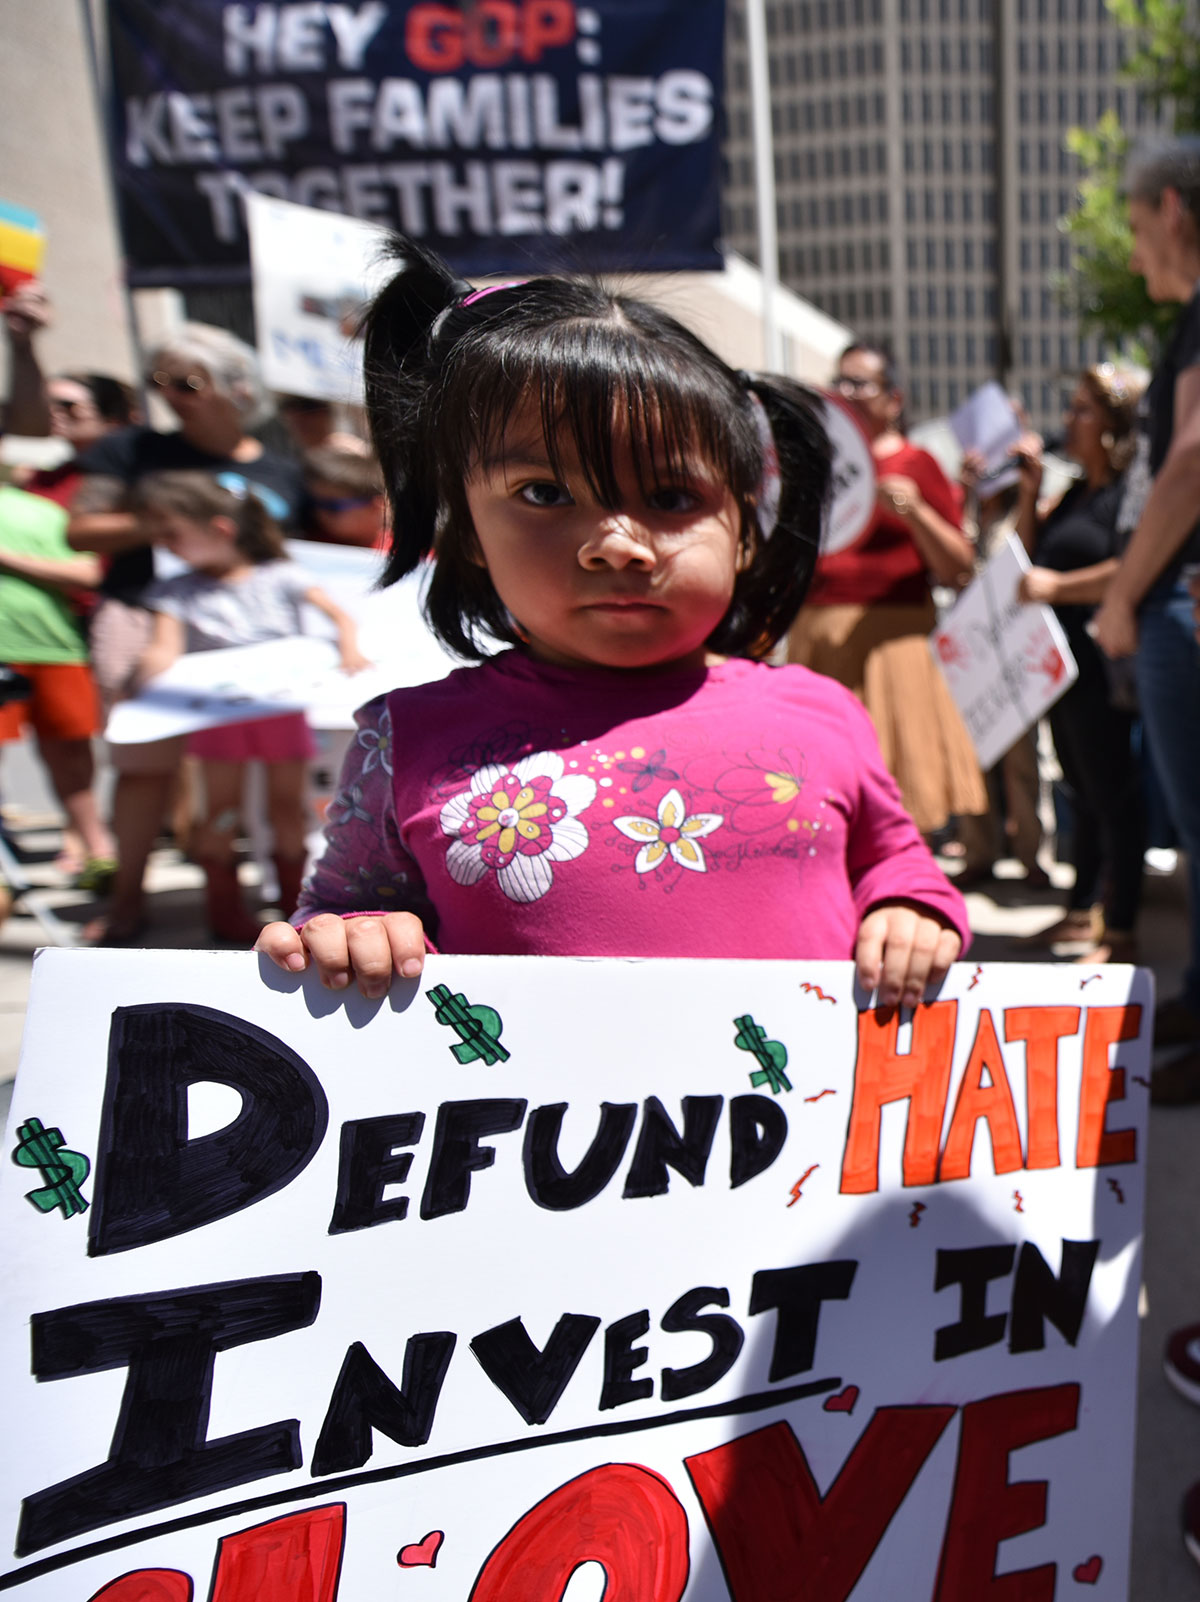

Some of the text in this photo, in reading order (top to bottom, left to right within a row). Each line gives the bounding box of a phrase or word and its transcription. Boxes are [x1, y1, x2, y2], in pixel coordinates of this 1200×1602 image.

[125, 68, 713, 168] KEEP FAMILIES
[222, 0, 600, 75] HEY GOP:
[88, 999, 1142, 1258] DEFUND HATE
[16, 1238, 1100, 1557] INVEST IN
